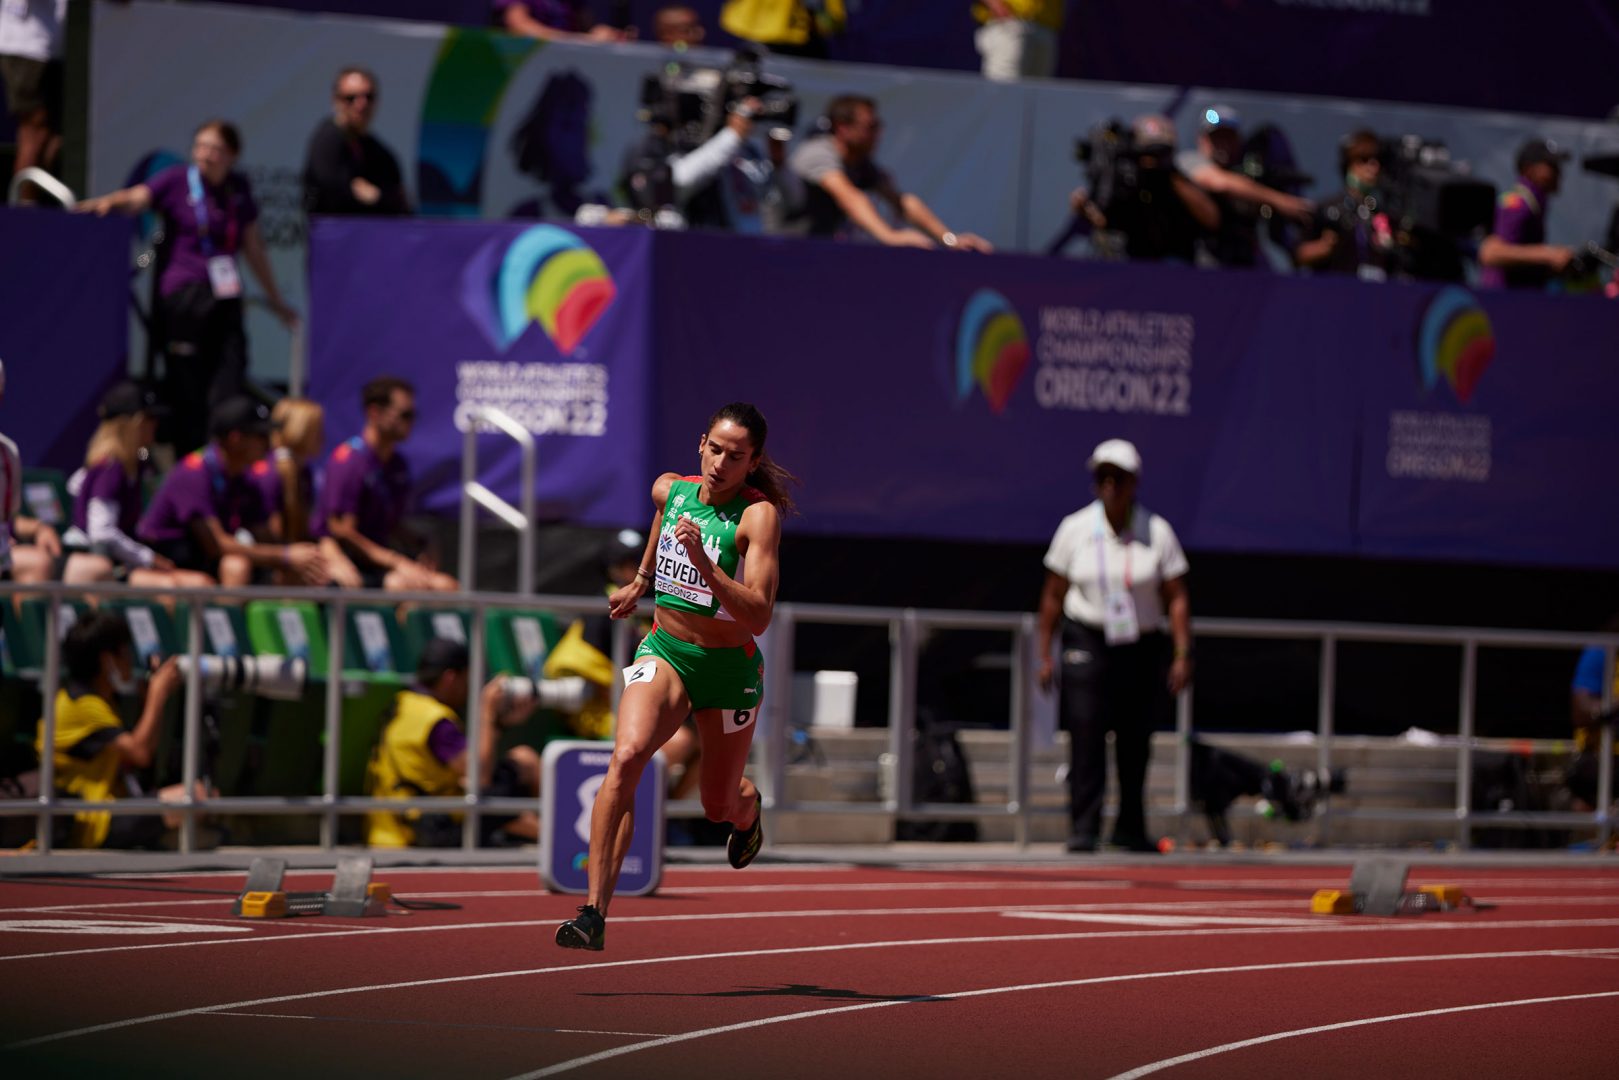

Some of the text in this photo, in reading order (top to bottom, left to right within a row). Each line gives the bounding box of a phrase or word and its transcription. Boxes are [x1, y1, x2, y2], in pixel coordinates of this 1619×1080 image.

[1034, 363, 1191, 416] OREGON22
[655, 580, 698, 602] REGON22
[733, 709, 750, 726] 6
